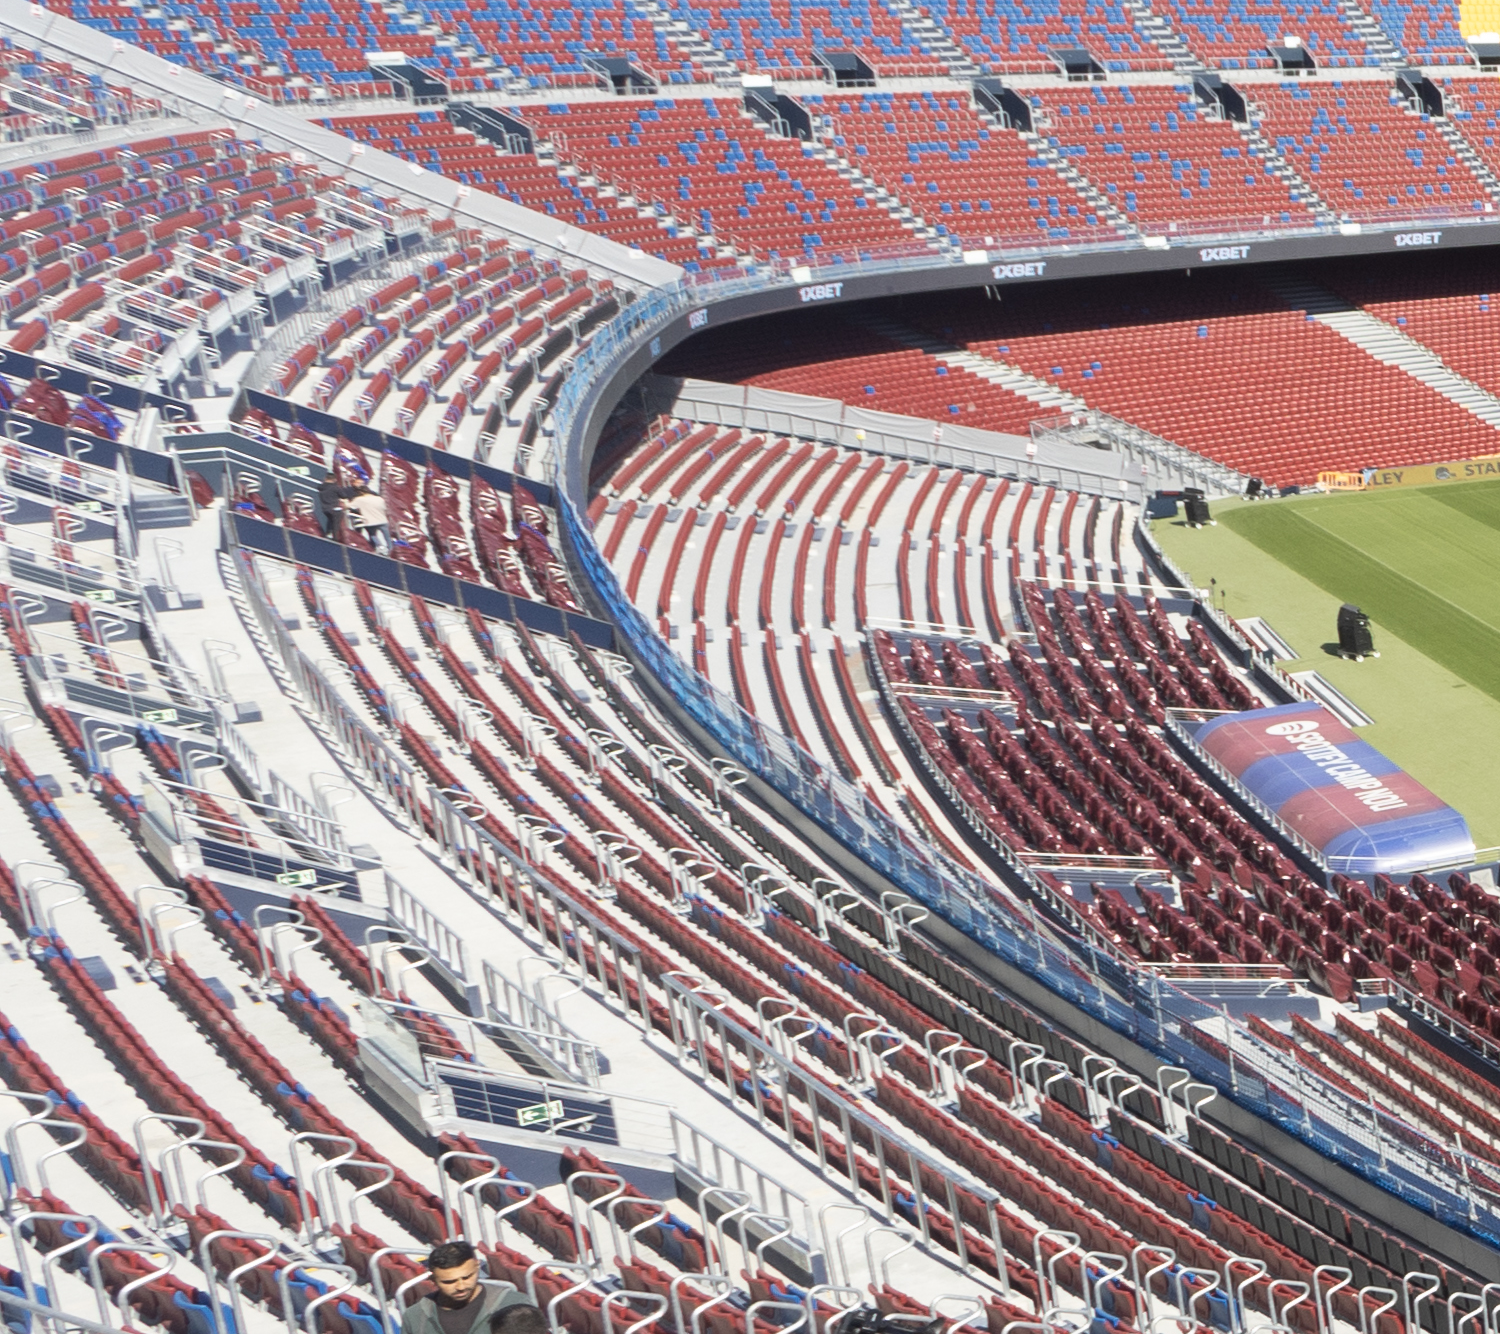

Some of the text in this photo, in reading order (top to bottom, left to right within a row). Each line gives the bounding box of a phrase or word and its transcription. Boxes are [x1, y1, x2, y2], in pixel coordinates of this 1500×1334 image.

[1394, 231, 1442, 247] 1XBET
[1199, 245, 1250, 262] 1XBET
[992, 261, 1046, 279] 1XBET
[799, 283, 843, 302] 1XBET
[1285, 731, 1408, 812] SPOTIFY CAMP NOU
